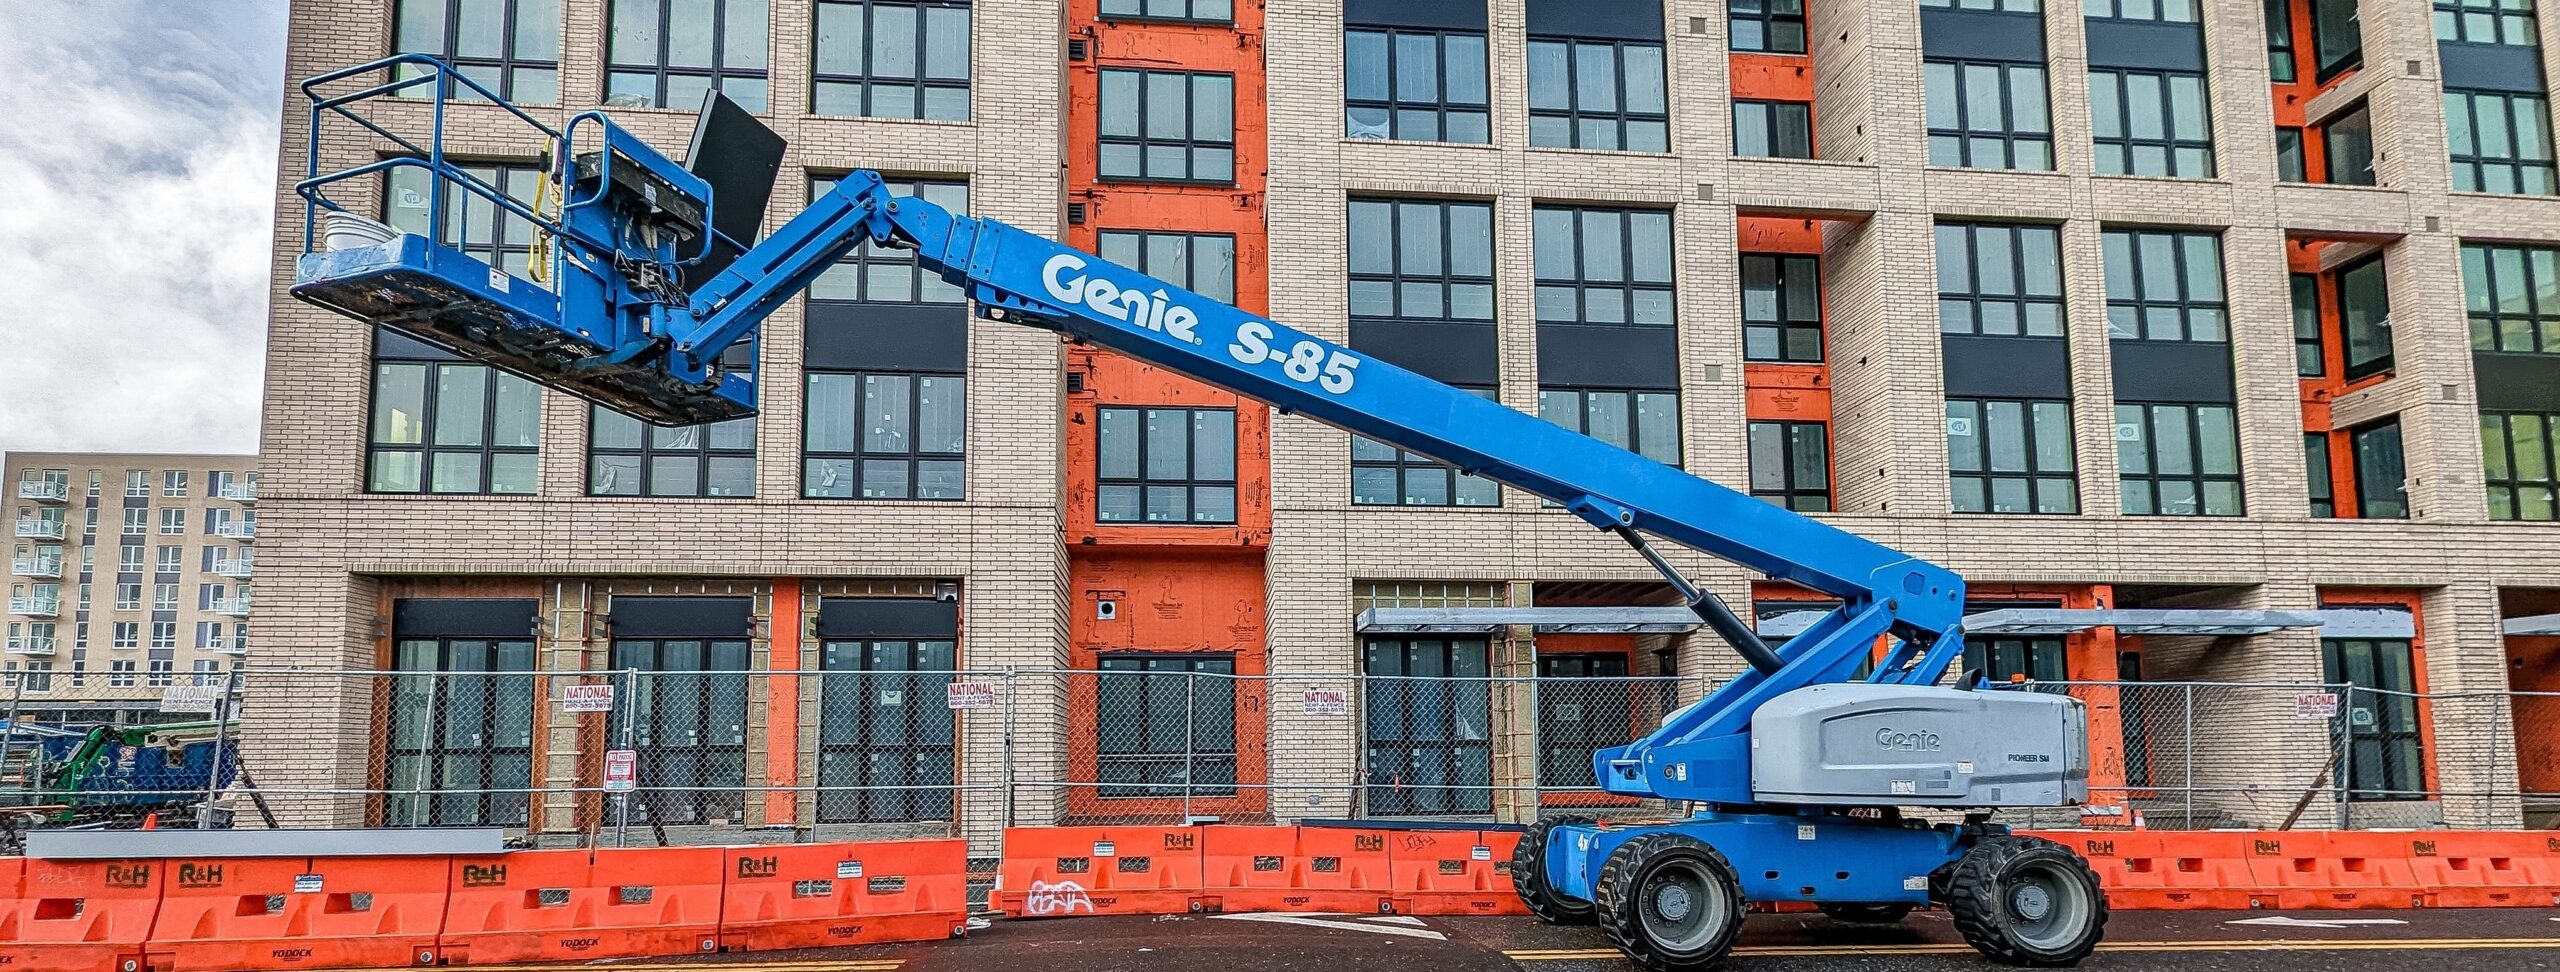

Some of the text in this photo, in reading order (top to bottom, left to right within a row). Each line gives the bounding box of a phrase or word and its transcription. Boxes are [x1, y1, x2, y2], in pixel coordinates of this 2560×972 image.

[1041, 253, 1361, 394] Genie S-85
[165, 687, 215, 699] NATIONAL
[566, 686, 611, 699] NATIONAL
[950, 684, 993, 696] NATIONAL
[1305, 691, 1344, 703] NATIONAL
[2298, 695, 2336, 706] NATIONAL
[1876, 727, 1941, 751] Genie
[2008, 753, 2038, 762] PIONEER
[1164, 833, 1194, 847] R&H
[1355, 834, 1383, 848] R&H
[2254, 839, 2280, 852] R&H
[2087, 840, 2114, 853] R&H
[738, 856, 778, 873] R&H
[106, 864, 151, 882] R&H
[179, 863, 223, 883] R&H
[1090, 897, 1118, 905] ODOCK
[1283, 896, 1310, 904] YODOCK
[1470, 900, 1497, 908] YODOCK
[827, 925, 863, 936] YODOCK
[560, 938, 600, 948] YODOCK
[272, 948, 313, 958] YODOCK
